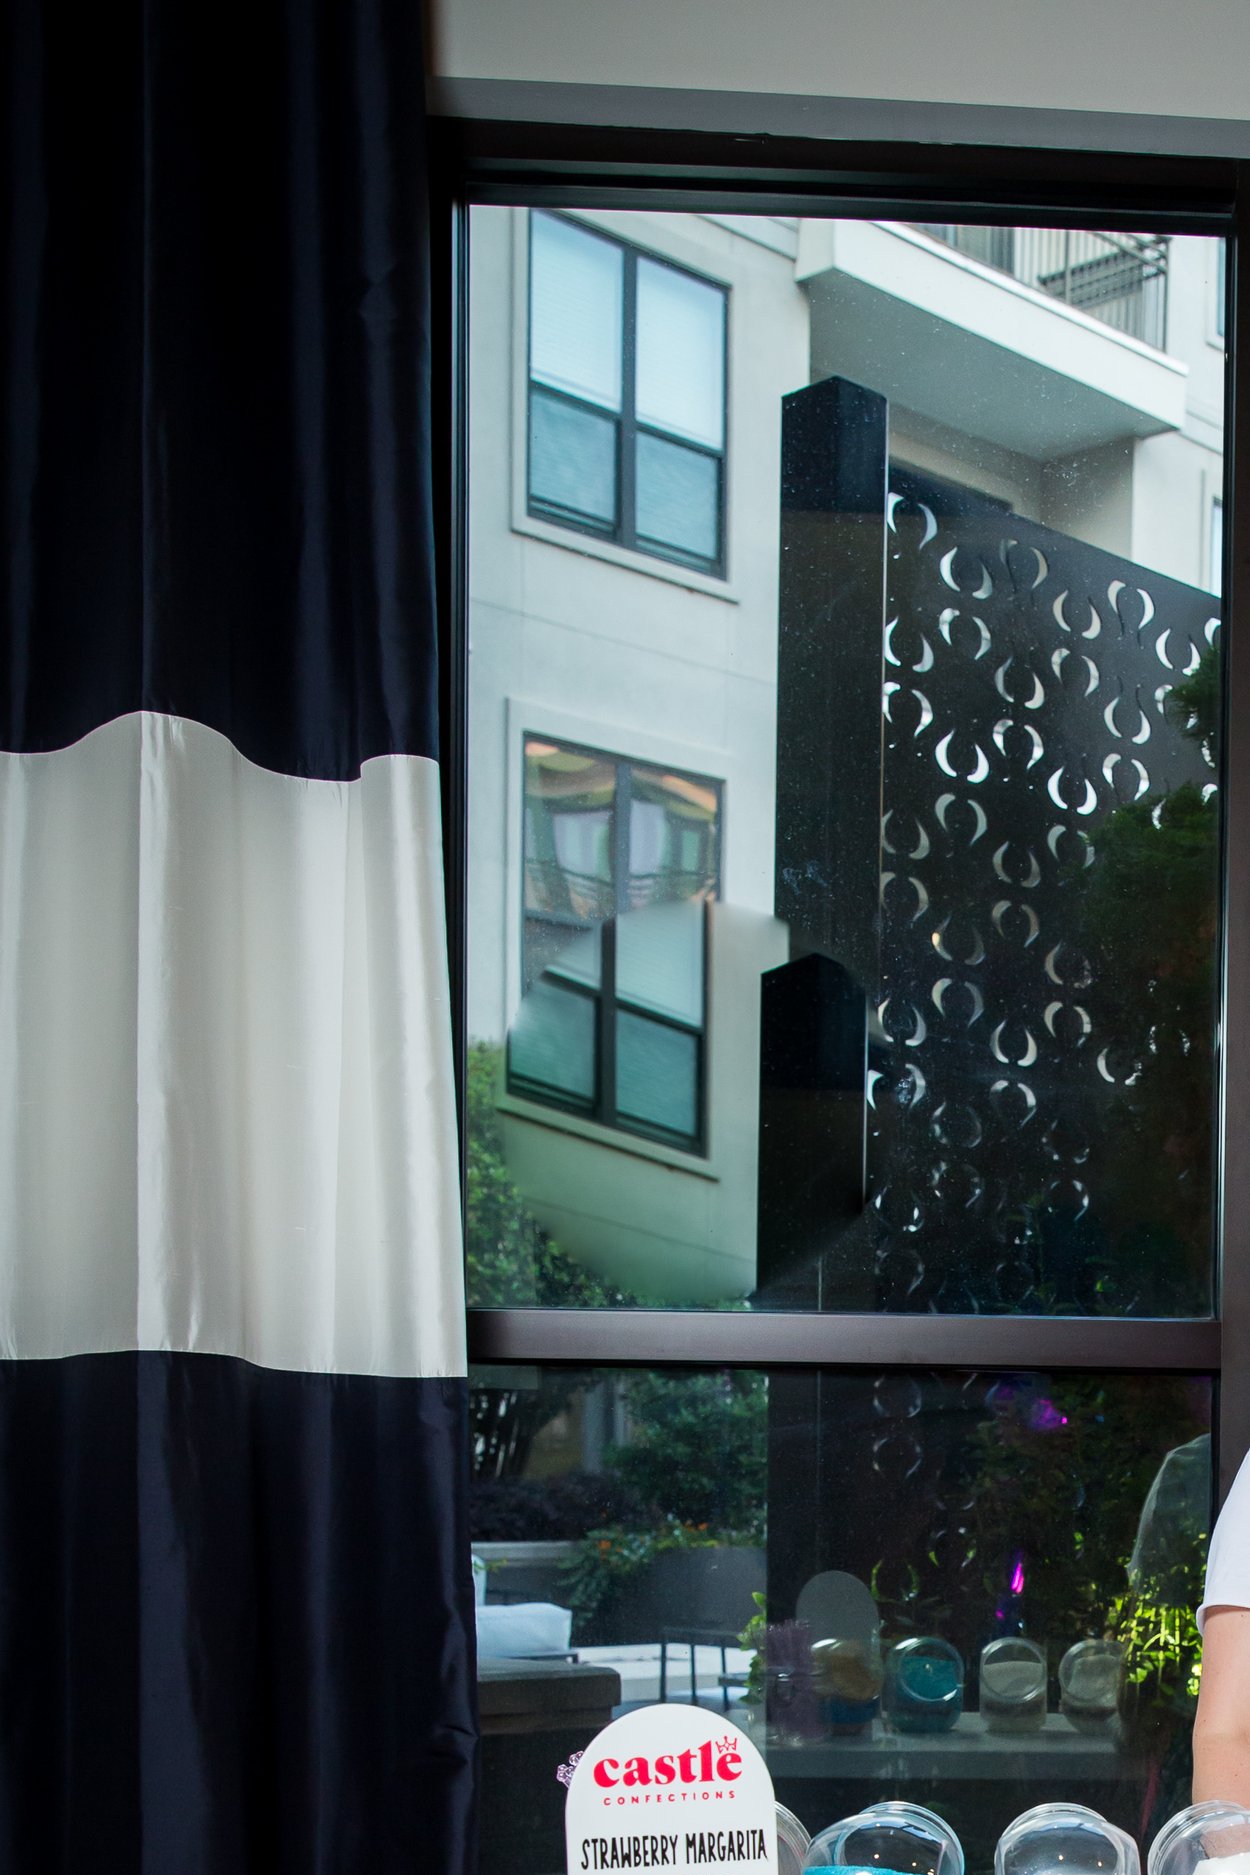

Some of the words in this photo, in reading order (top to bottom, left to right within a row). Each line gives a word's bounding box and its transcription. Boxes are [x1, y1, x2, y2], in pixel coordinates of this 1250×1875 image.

[593, 1738, 744, 1788] castle
[603, 1790, 736, 1806] CONFECTIONS
[581, 1834, 678, 1870] STRAWBERRY
[686, 1829, 768, 1863] MARGARITA
